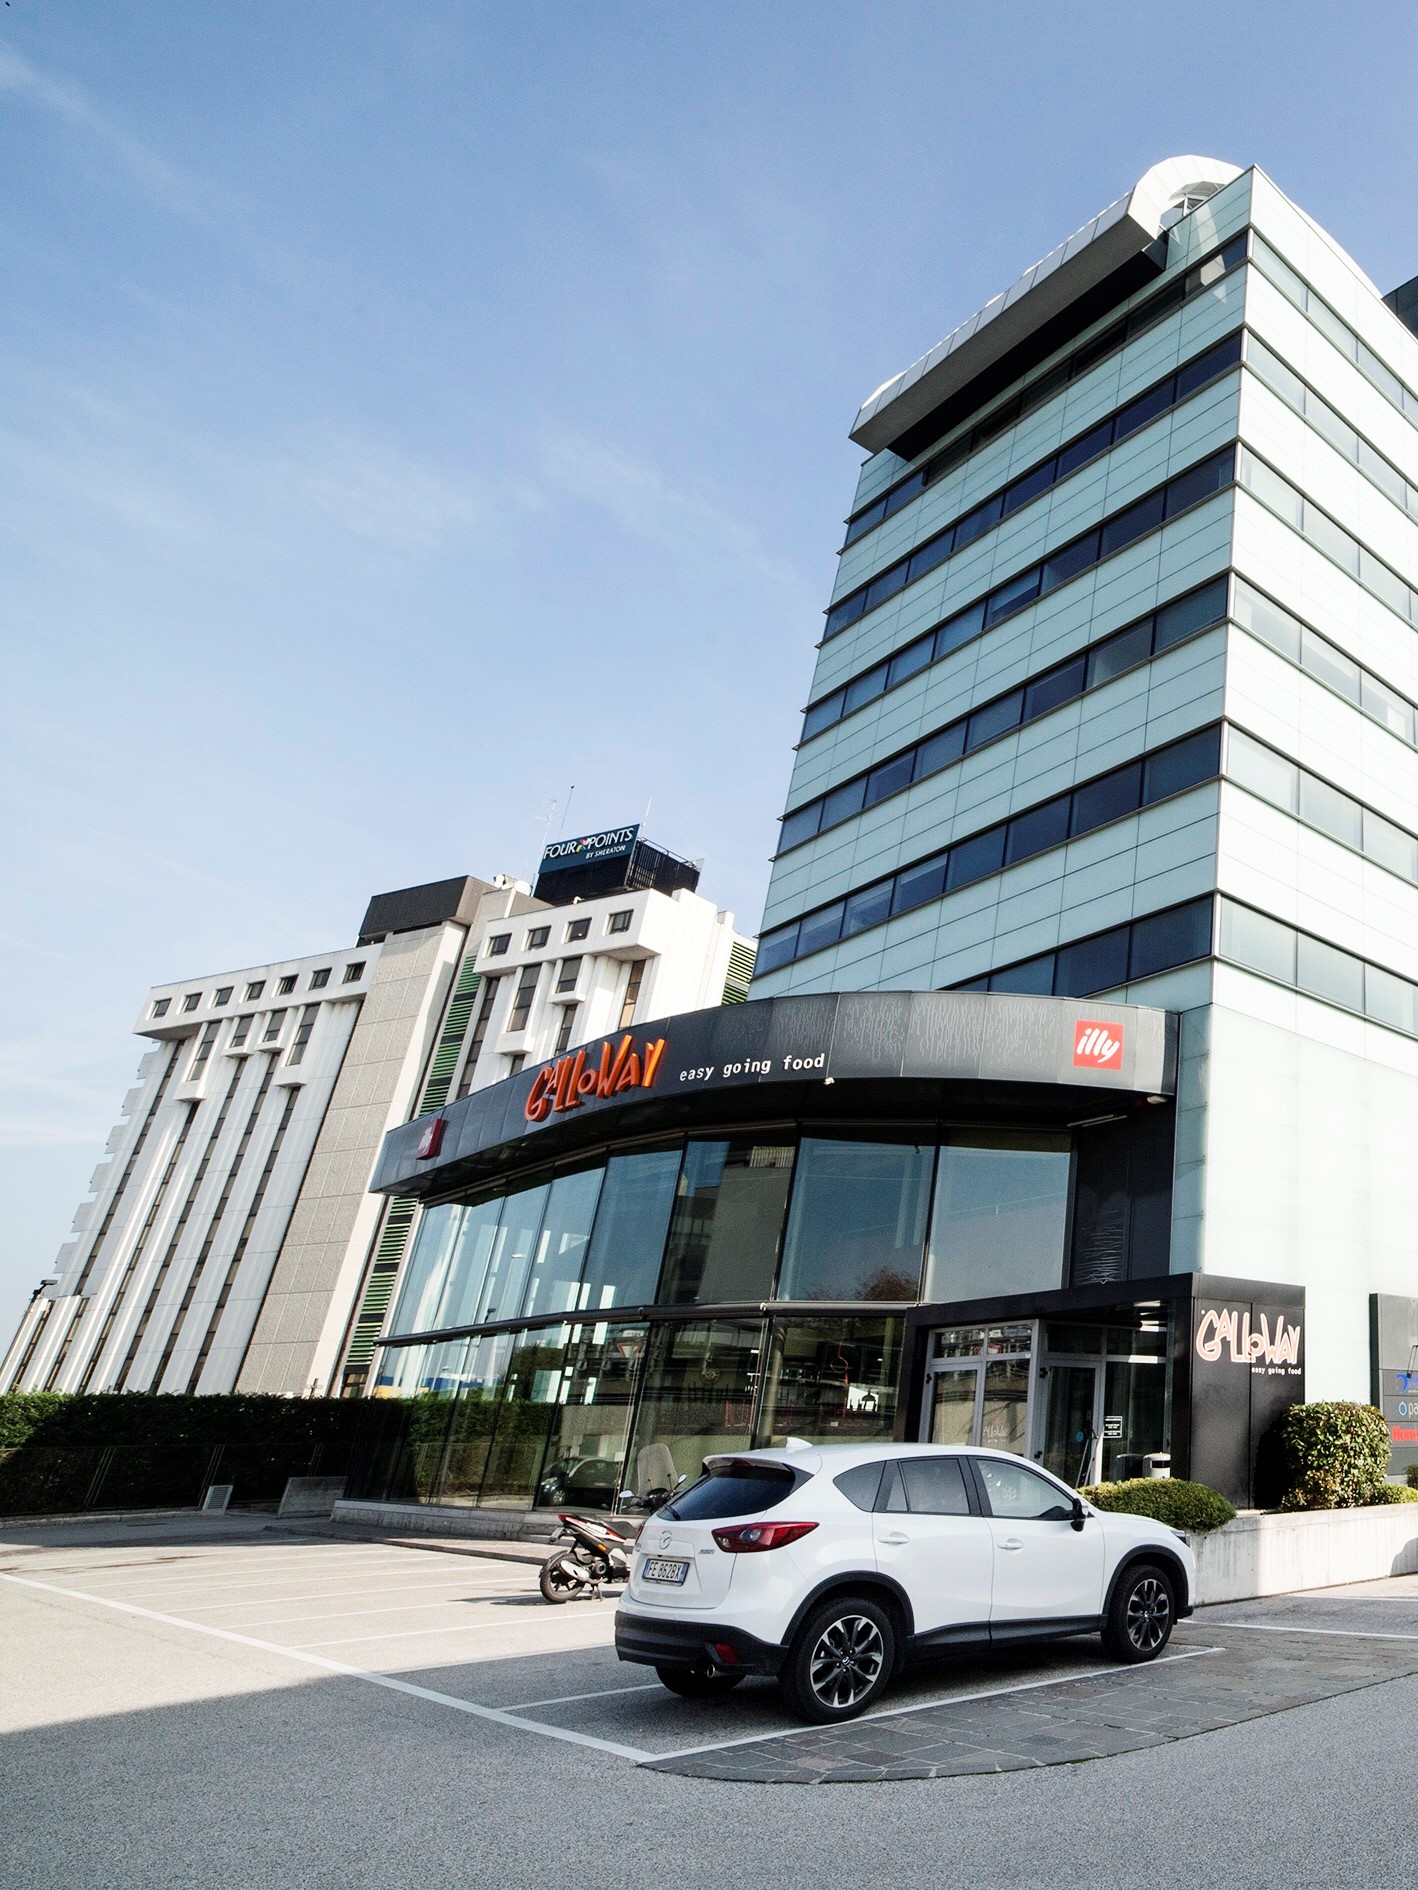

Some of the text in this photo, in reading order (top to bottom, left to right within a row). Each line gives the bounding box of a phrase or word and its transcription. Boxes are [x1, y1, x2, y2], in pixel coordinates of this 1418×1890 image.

[543, 827, 634, 860] FOUR POINTS
[585, 844, 627, 860] BY SHERATON
[1076, 1027, 1121, 1064] illy
[679, 1052, 825, 1083] easy going food
[1251, 1366, 1302, 1376] easy going food
